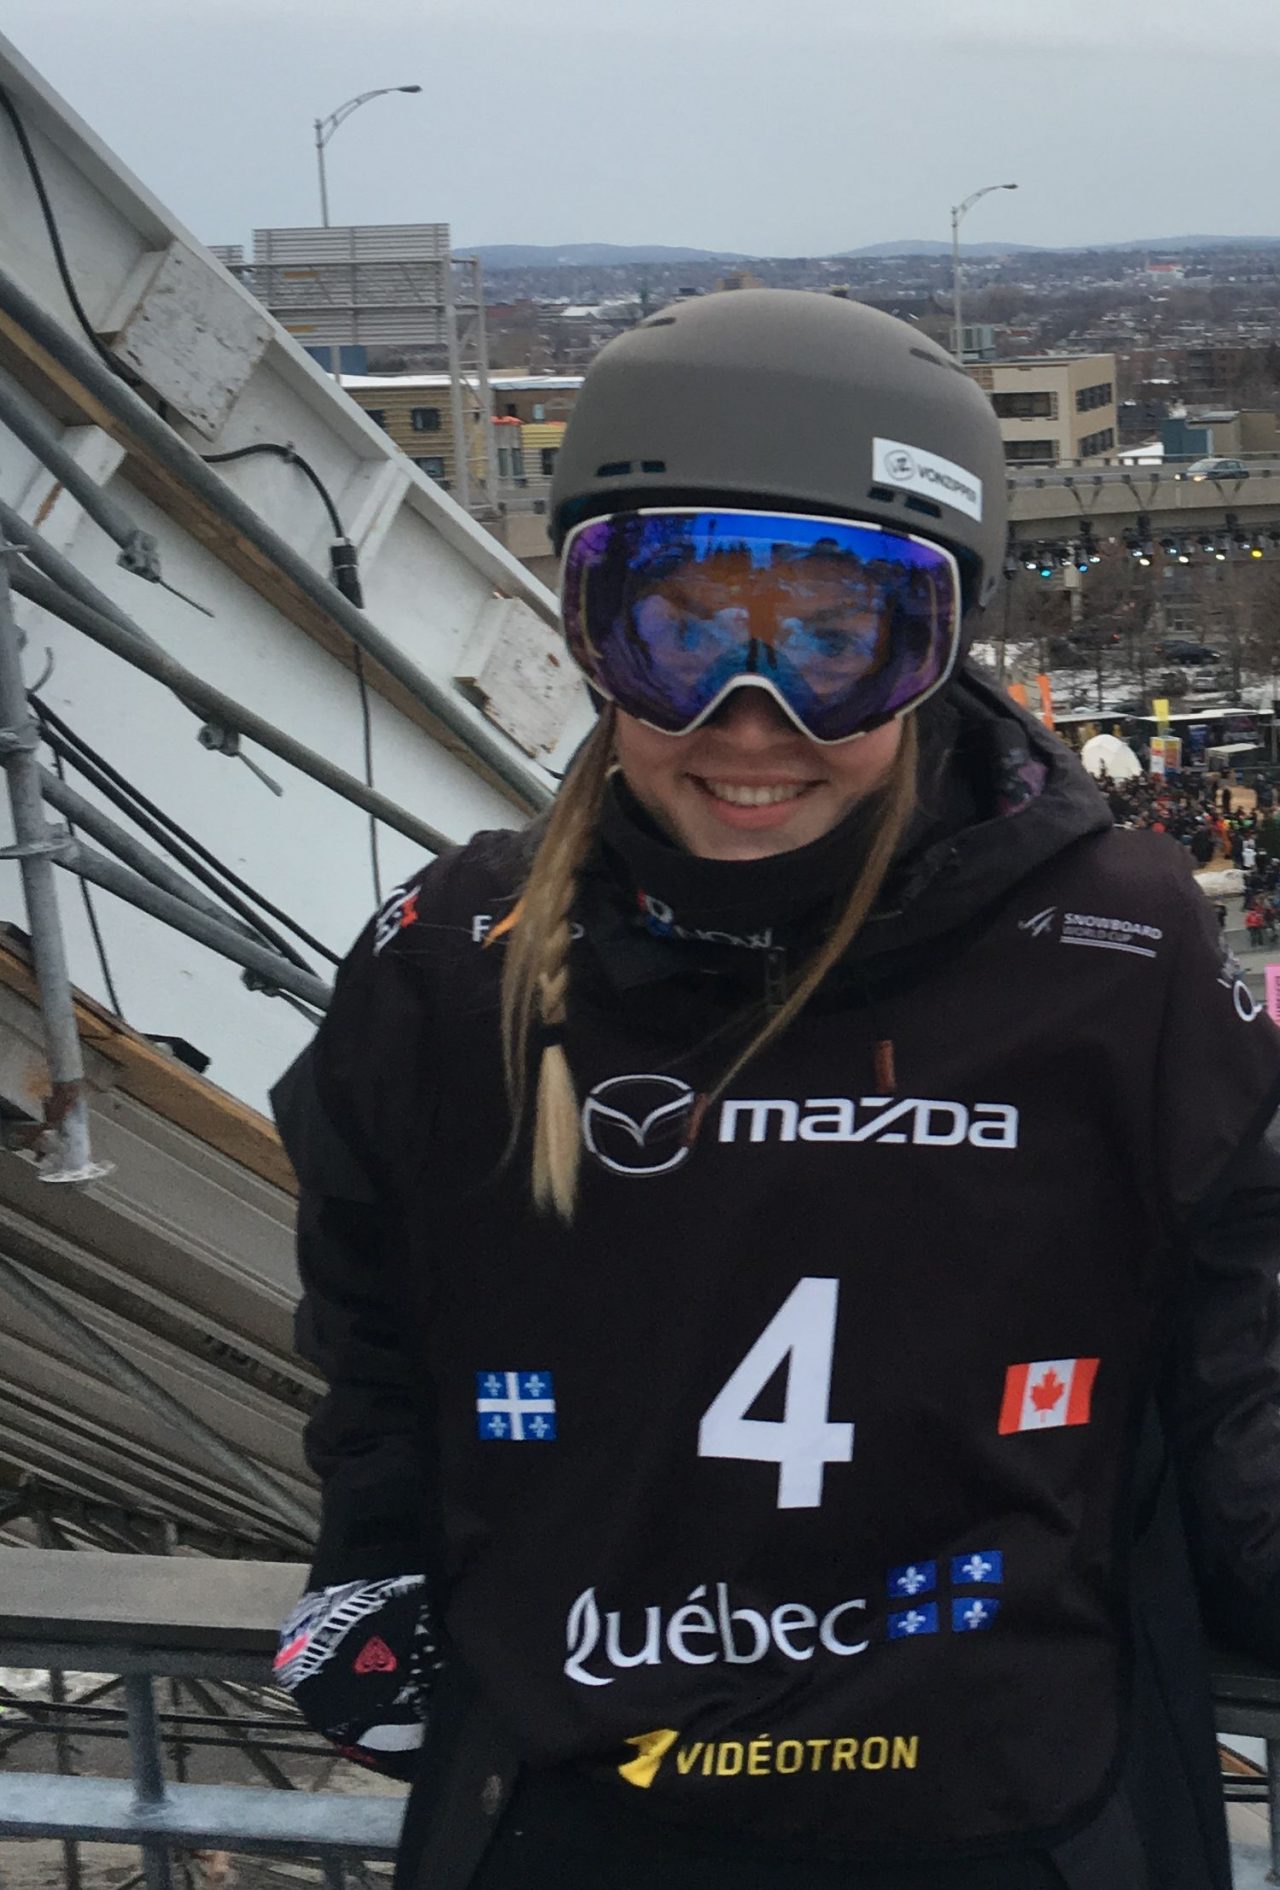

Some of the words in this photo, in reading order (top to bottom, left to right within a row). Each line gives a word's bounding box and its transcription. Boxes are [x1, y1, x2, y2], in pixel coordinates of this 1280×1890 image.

[1063, 912, 1163, 940] SNOWBOARD
[697, 1277, 855, 1509] 4
[563, 1582, 869, 1686] Québec
[675, 1731, 919, 1776] VIDÉOTRON
